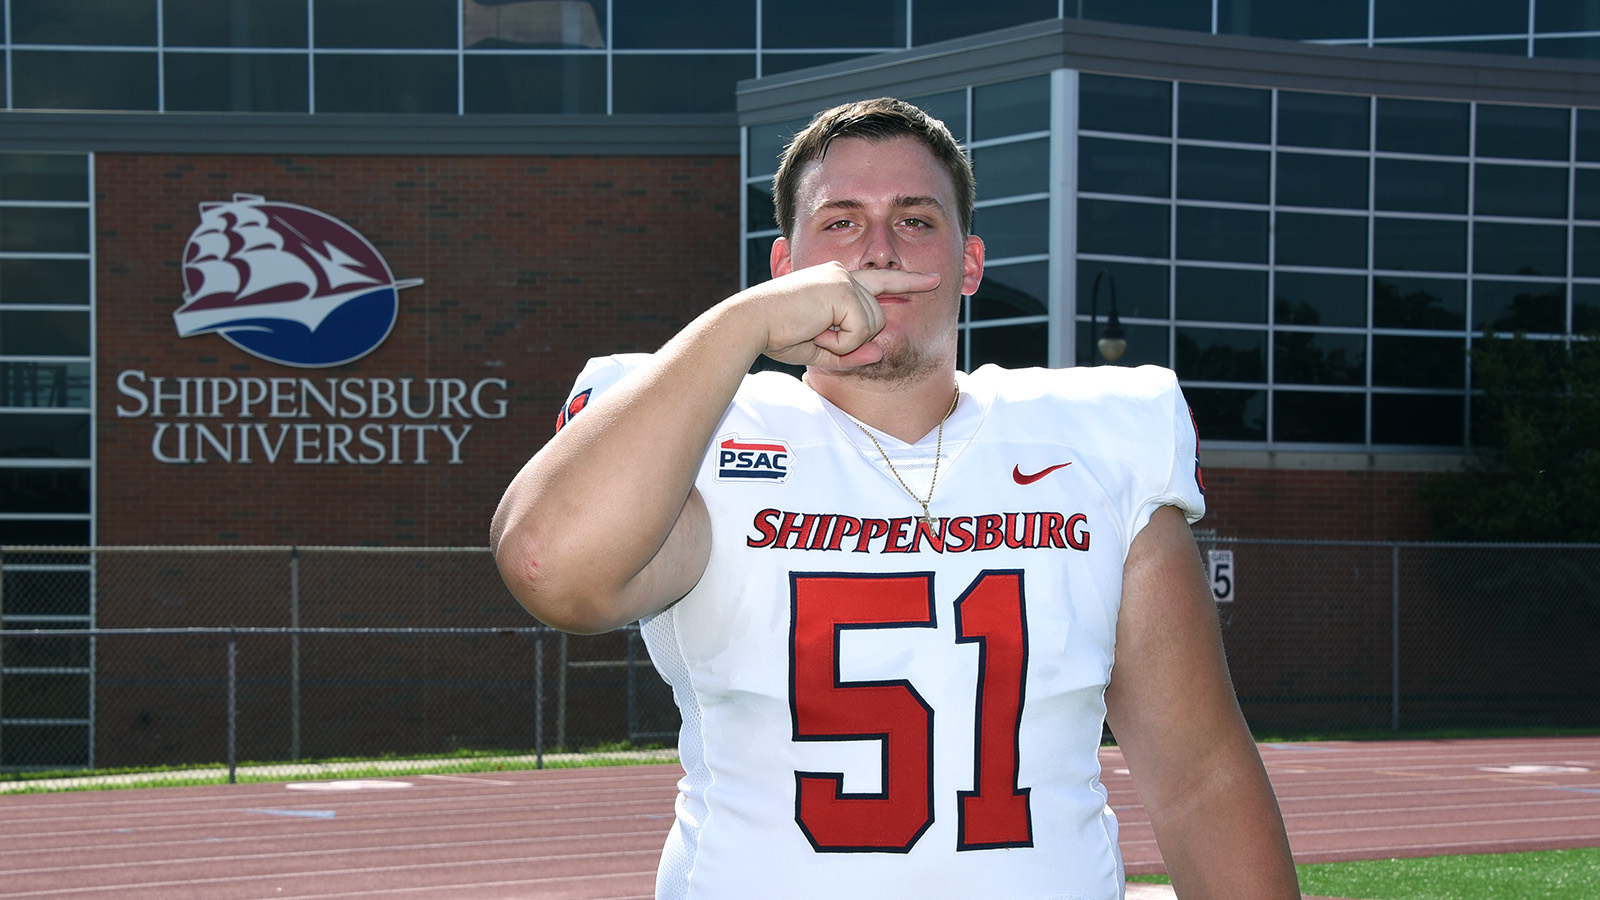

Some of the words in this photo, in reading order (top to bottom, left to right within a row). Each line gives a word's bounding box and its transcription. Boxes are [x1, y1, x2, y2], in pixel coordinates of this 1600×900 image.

[116, 369, 509, 418] SHIPPENSBURG
[151, 422, 472, 464] UNIVERSITY
[719, 450, 788, 470] PSAC
[746, 508, 1091, 554] SHIPPENSBURG
[1214, 564, 1231, 598] 5
[788, 568, 1034, 854] 51
